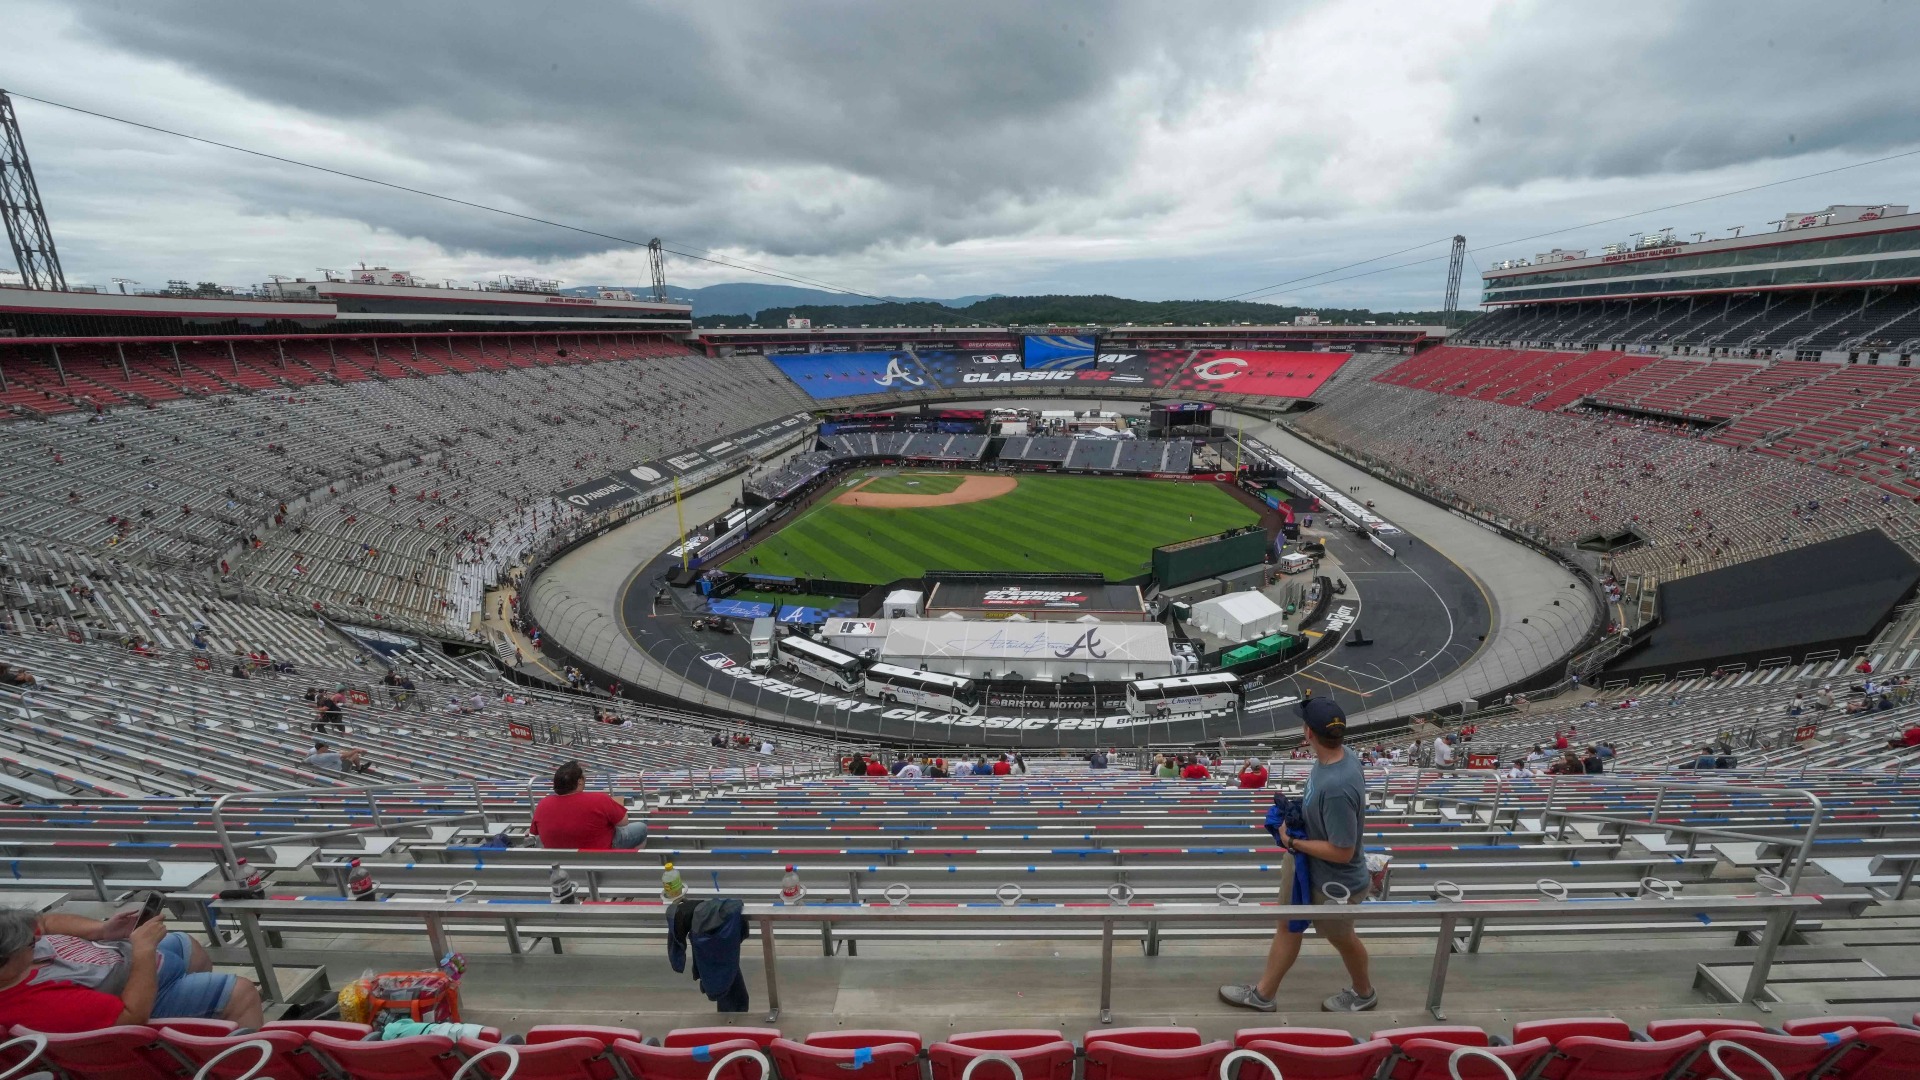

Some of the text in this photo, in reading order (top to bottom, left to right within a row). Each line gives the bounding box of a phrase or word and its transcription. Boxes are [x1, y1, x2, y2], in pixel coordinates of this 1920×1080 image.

[1605, 247, 1677, 262] WORLD'S FASTEST HALF-MILE
[963, 371, 1076, 383] CLASSIC
[583, 483, 625, 501] FANDUEL
[721, 666, 886, 713] SPEEDWAY
[881, 708, 1051, 730] CLASSIC
[896, 685, 927, 699] Champion
[1001, 699, 1046, 709] BRISTOL
[1050, 700, 1089, 709] MOTOR
[1171, 696, 1202, 706] Champion
